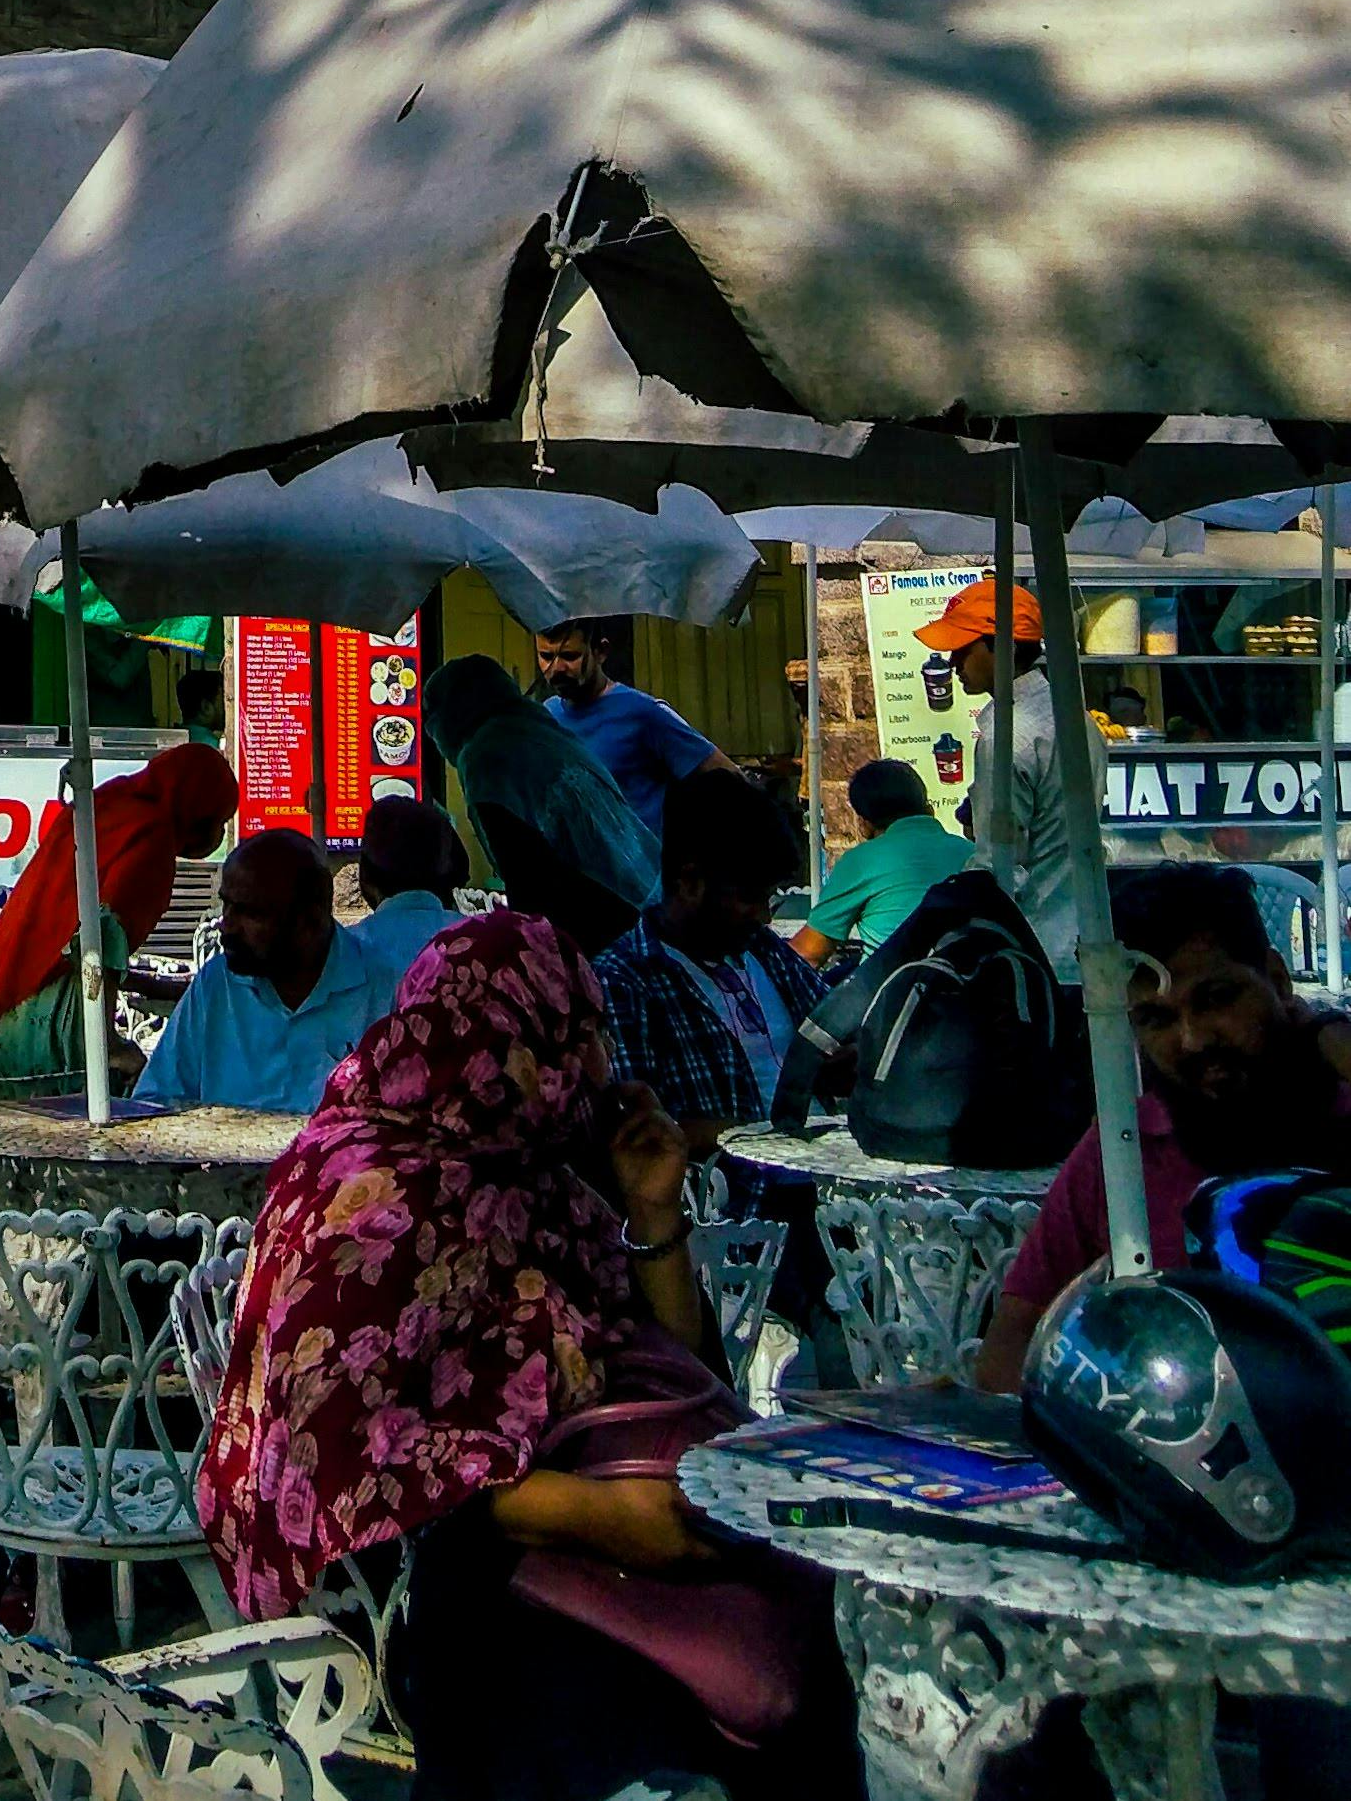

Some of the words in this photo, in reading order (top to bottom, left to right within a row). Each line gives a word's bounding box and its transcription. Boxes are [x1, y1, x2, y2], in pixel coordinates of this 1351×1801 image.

[891, 575, 928, 590] Famous
[931, 573, 945, 587] Ice
[949, 572, 978, 585] Cream
[882, 651, 907, 660] Mango
[886, 693, 913, 702] Chikoo
[889, 714, 909, 723] Litchi
[891, 735, 931, 744] Kharbooza
